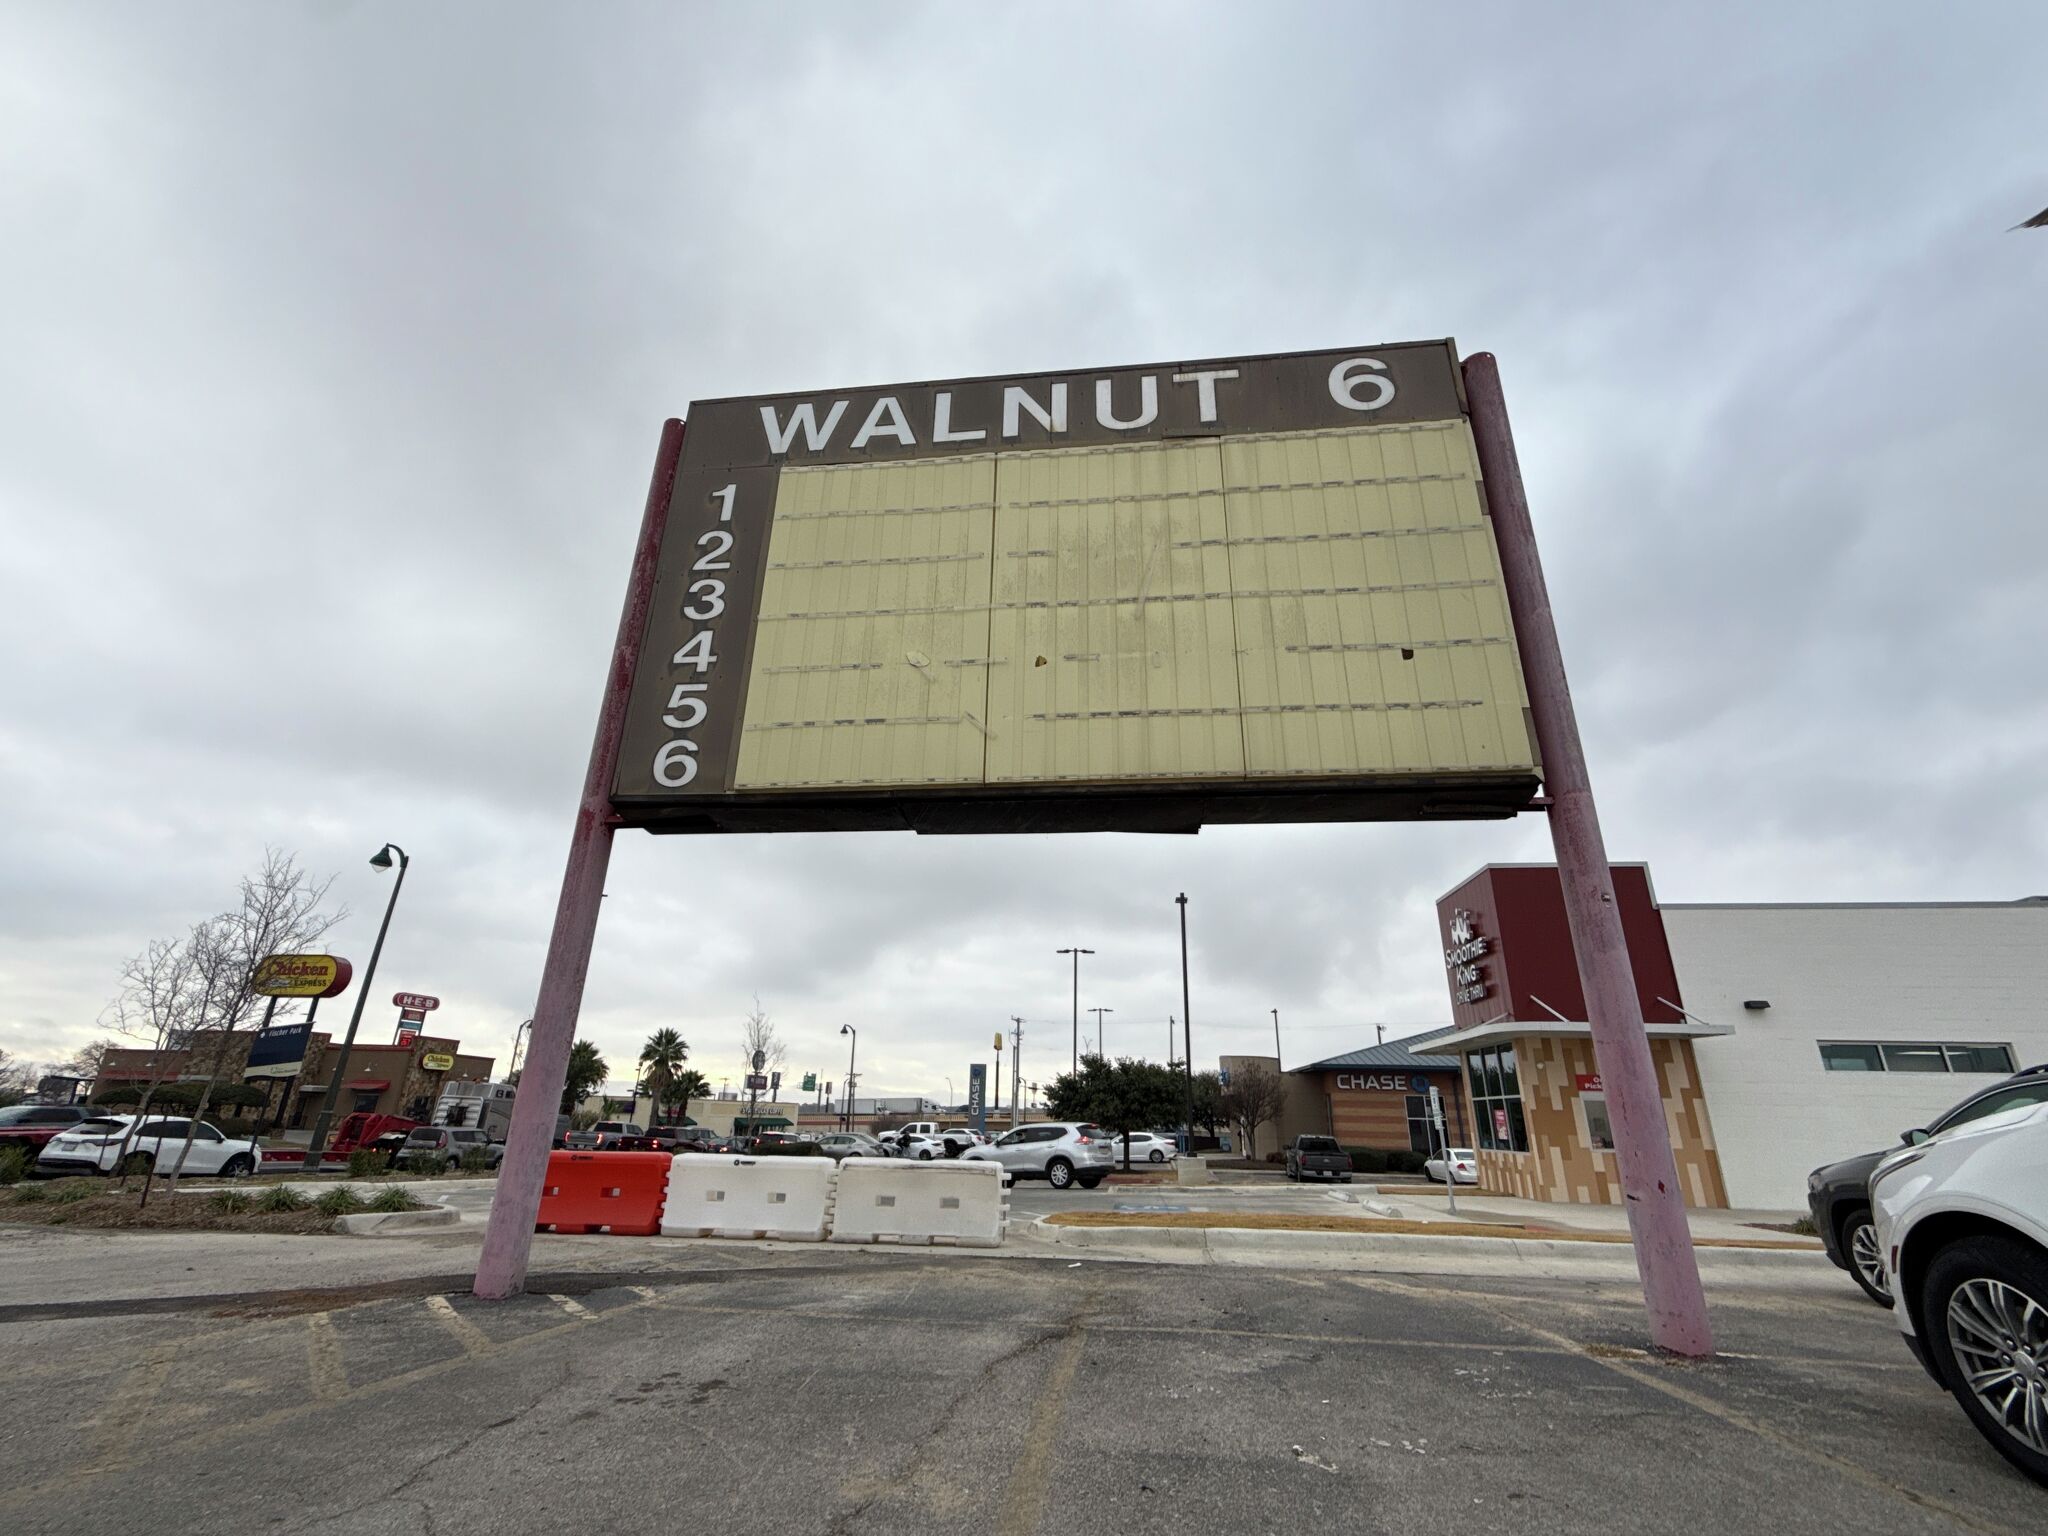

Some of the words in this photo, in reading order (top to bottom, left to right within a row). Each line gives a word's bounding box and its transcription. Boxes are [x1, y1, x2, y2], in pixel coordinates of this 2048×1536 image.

[759, 369, 1239, 454] WALNUT
[1328, 357, 1395, 411] 6
[712, 484, 737, 521] 1
[692, 530, 734, 570] 2
[683, 578, 726, 620] 3
[673, 630, 718, 672] 4
[662, 684, 708, 728] 5
[653, 739, 699, 787] 6
[970, 1077, 981, 1117] CHASE
[1337, 1074, 1408, 1090] CHASE
